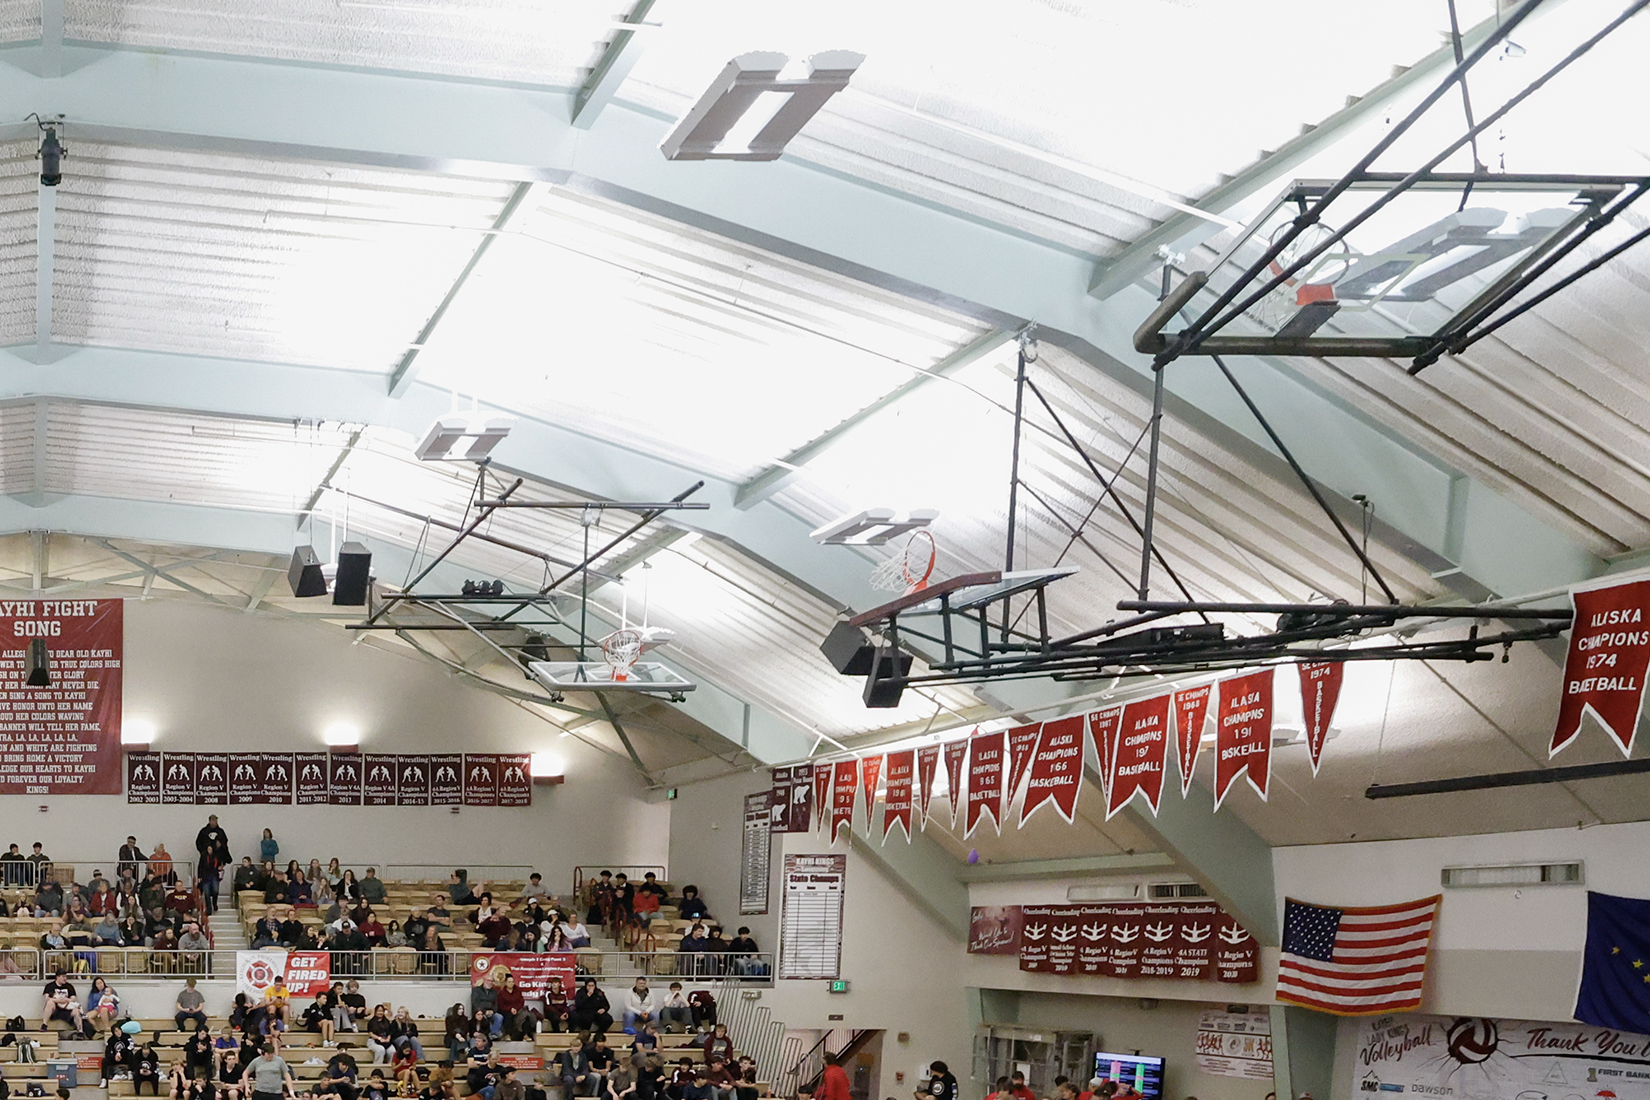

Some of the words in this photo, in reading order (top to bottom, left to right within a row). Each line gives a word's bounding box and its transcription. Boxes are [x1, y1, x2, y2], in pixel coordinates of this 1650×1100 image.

[43, 602, 97, 616] FIGHT
[14, 621, 61, 636] SONG
[1310, 667, 1330, 679] 1974
[1313, 681, 1322, 757] BASKETBALL
[291, 957, 317, 967] GET
[288, 970, 327, 980] FIRED
[1181, 968, 1199, 976] 2019
[287, 983, 309, 992] UP!
[1360, 1025, 1432, 1066] Volleyball
[1528, 1028, 1588, 1052] Thank
[1594, 1030, 1638, 1055] You
